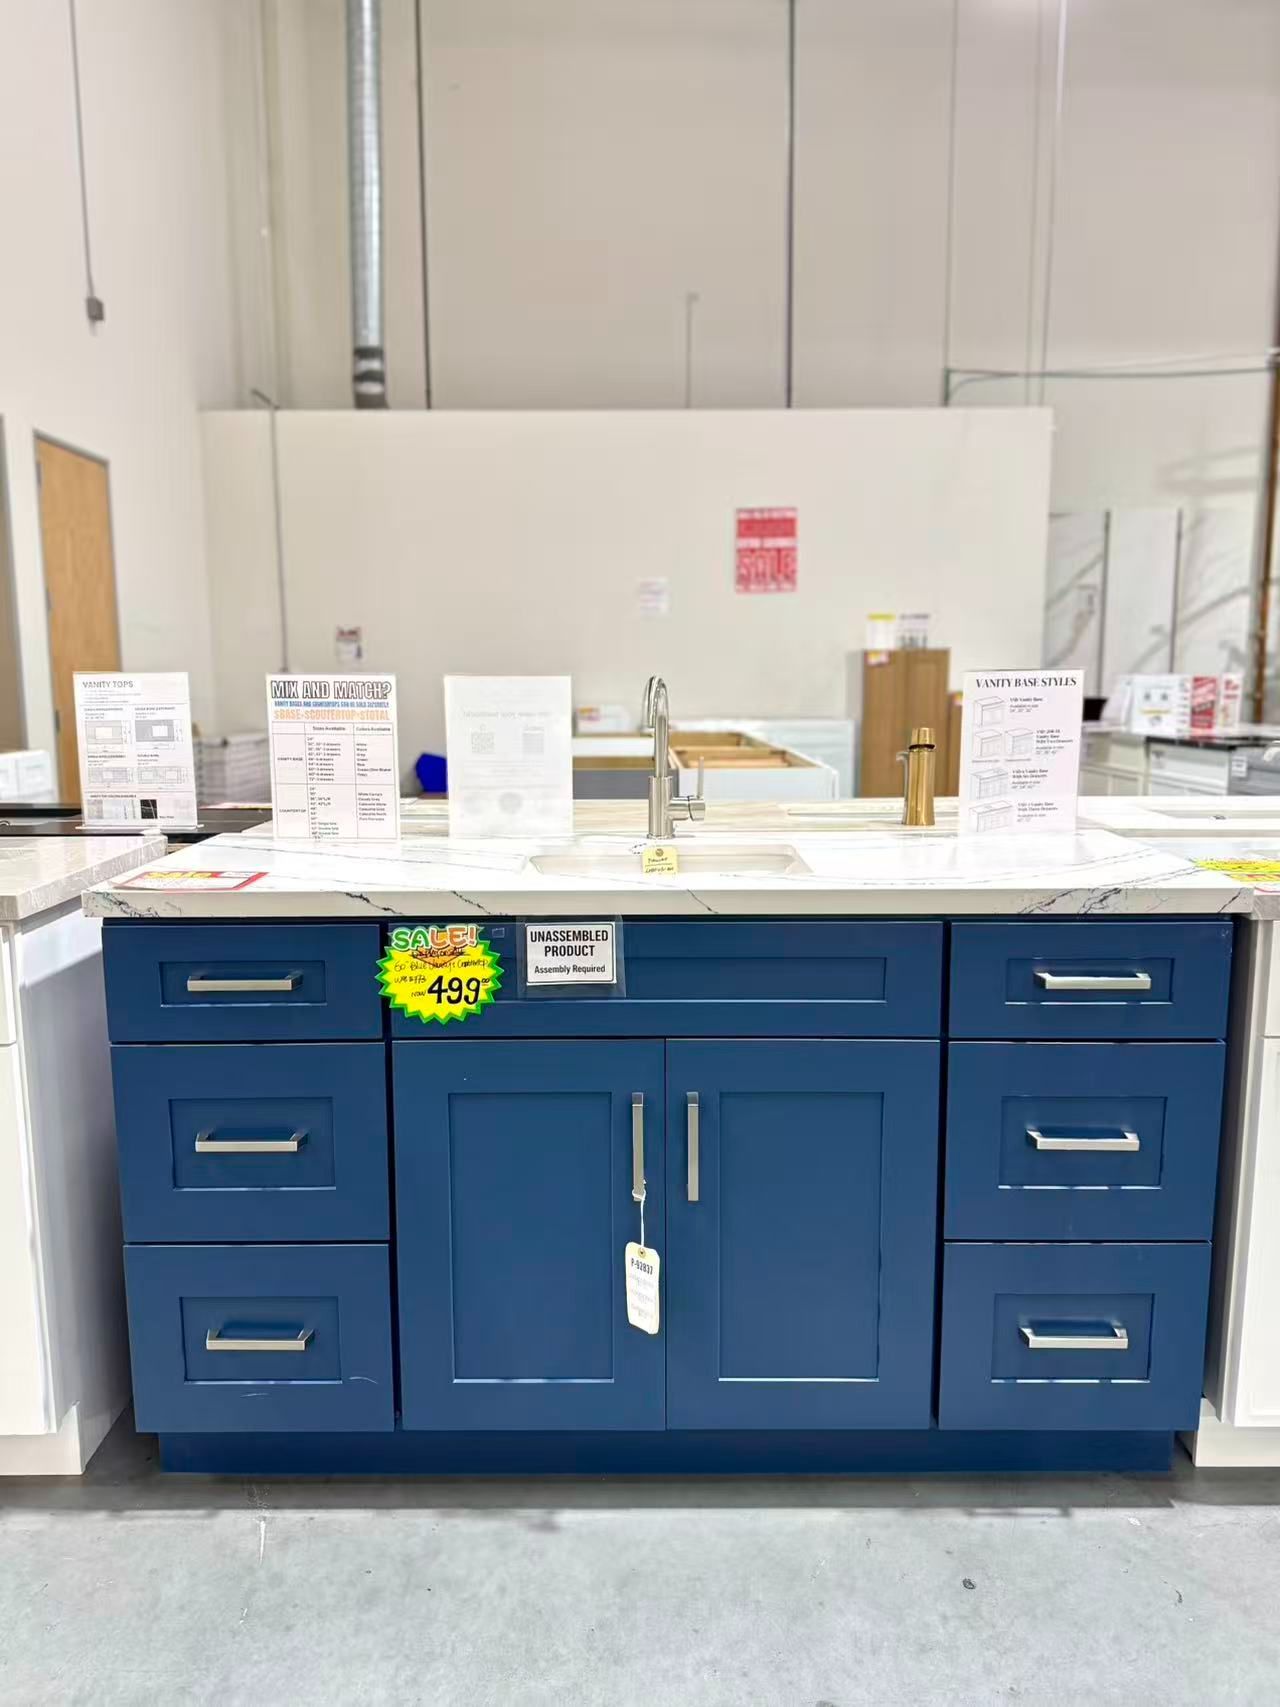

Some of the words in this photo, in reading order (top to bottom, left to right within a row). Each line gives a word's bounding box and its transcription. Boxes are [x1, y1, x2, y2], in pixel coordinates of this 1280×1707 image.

[82, 681, 111, 689] VANITY
[113, 680, 134, 688] TOPS
[976, 678, 1012, 688] VANITY
[1015, 678, 1040, 688] BASE
[1041, 677, 1077, 687] STYLES
[271, 680, 298, 699] MIX
[303, 681, 330, 699] AND
[334, 681, 392, 700] MATCH?
[391, 924, 478, 951] SALE!
[530, 930, 609, 942] UNASSEMBLED
[544, 945, 595, 957] PRODUCT
[534, 965, 571, 975] Assembly
[572, 964, 606, 974] Required
[428, 975, 481, 1005] 499
